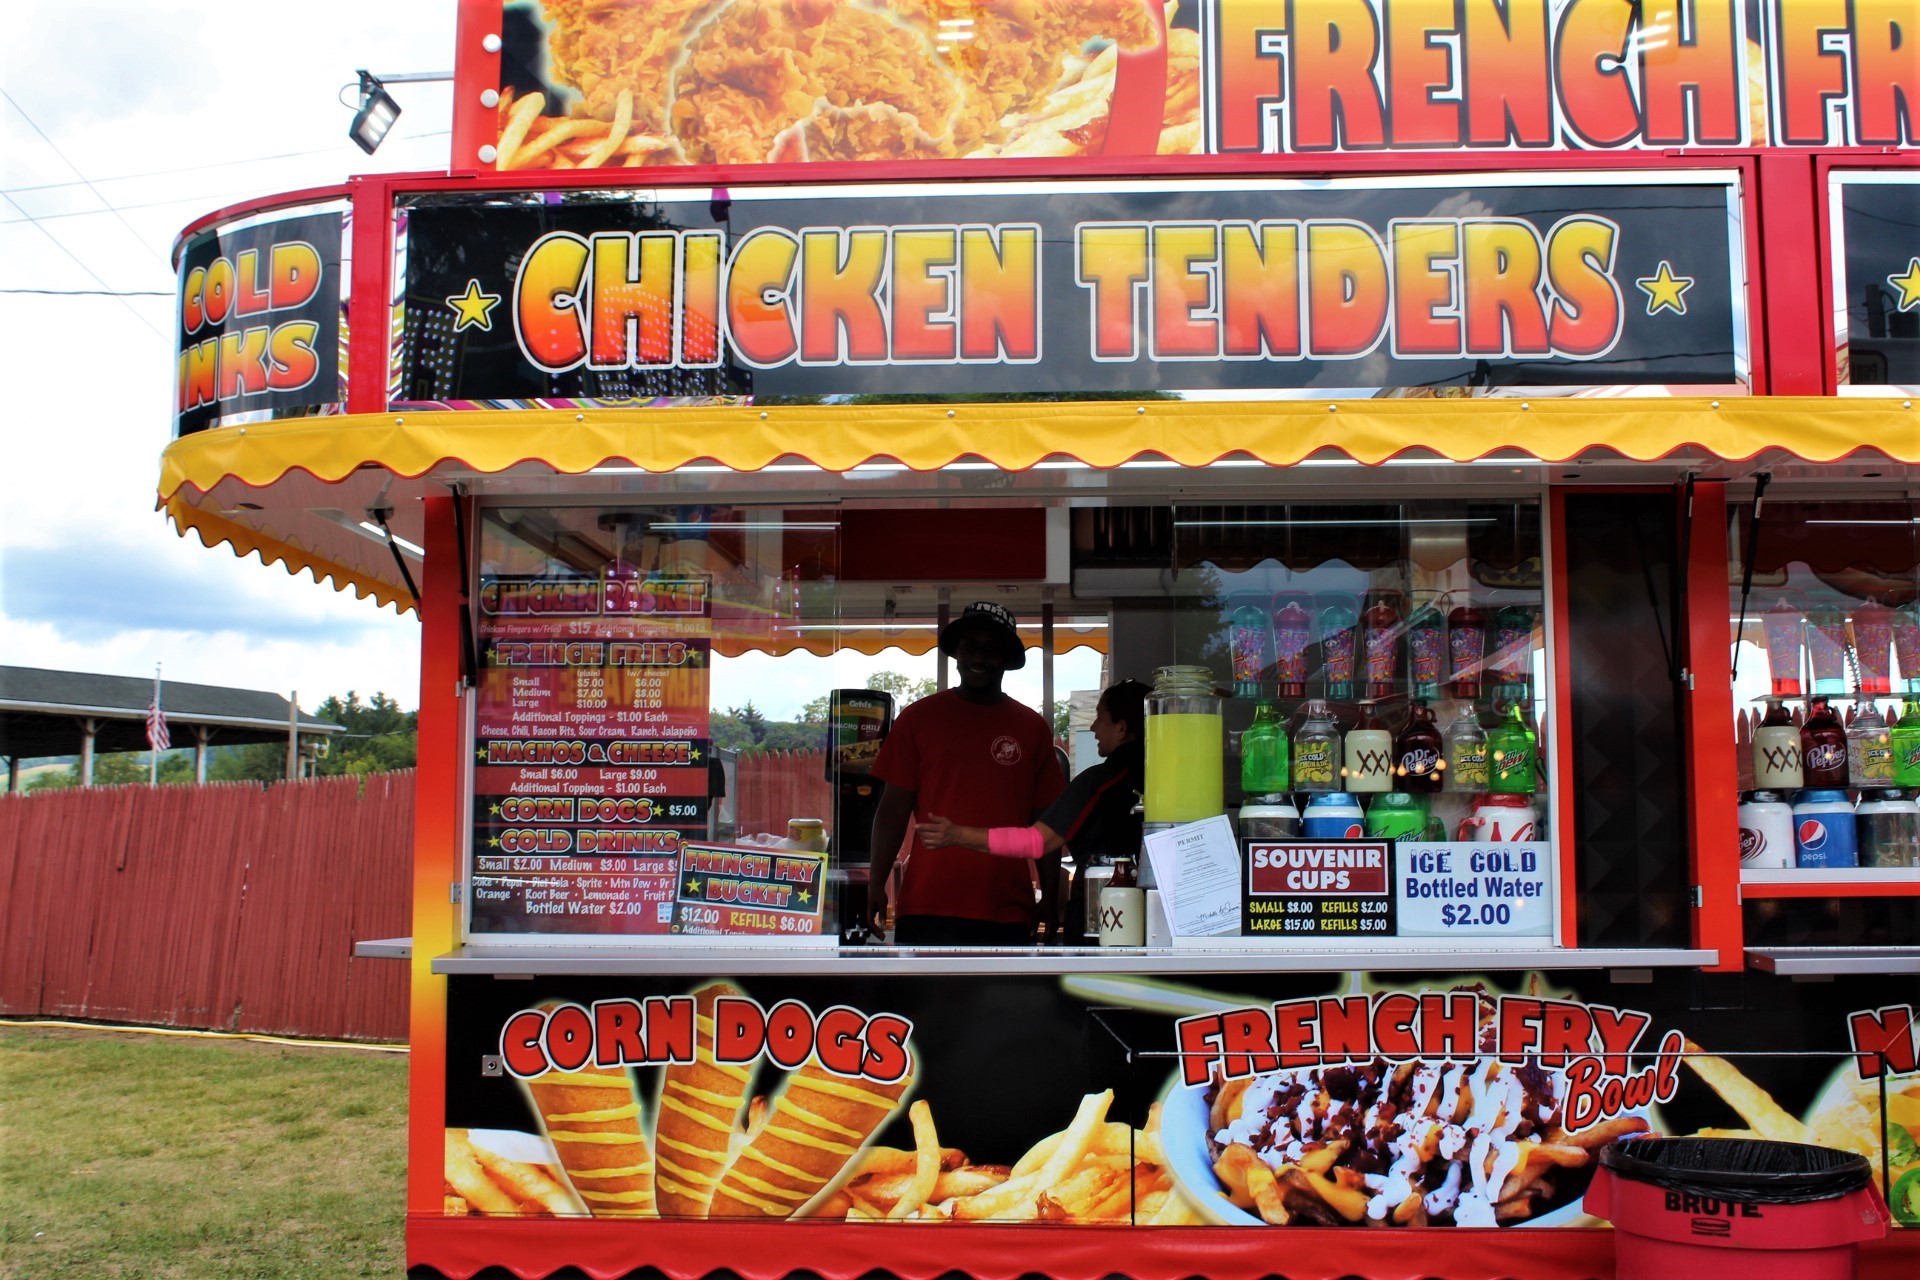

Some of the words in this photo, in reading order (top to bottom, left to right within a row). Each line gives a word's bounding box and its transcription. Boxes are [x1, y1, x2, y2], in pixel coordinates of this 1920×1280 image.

[1211, 0, 1745, 151] FRENCH
[184, 241, 322, 335] COLD
[513, 222, 1042, 372] CHICKEN
[1075, 213, 1625, 362] TENDERS
[180, 320, 319, 415] INKS
[481, 580, 599, 615] CHICKEN
[603, 580, 708, 614] BASKET
[507, 625, 531, 634] Fingers
[569, 621, 591, 634] $15
[596, 623, 634, 633] Additional
[637, 623, 668, 634] Toppings
[675, 623, 694, 633] $1.00
[496, 643, 603, 665] FRENCH
[610, 642, 687, 665] FRIES
[577, 669, 601, 677] (plain)
[513, 677, 539, 686] Small
[577, 678, 604, 687] $5.00
[635, 678, 661, 687] $6.00
[513, 688, 551, 697] Medium
[577, 689, 603, 698] $7.00
[635, 689, 660, 698] $8.00
[512, 698, 539, 708] Large
[576, 699, 607, 708] $10.00
[633, 699, 662, 708] $11.00
[512, 711, 562, 722] Additional
[564, 712, 606, 723] Toppings
[617, 711, 641, 722] $1.00
[644, 711, 668, 721] Each
[481, 725, 510, 736] Cheese,
[511, 725, 530, 736] Chili,
[532, 725, 557, 736] Bacon
[559, 725, 576, 736] Bits,
[578, 725, 596, 736] Sour
[598, 725, 627, 736] Cream,
[631, 725, 659, 736] Ranch,
[661, 725, 698, 738] Jalapeño
[488, 740, 585, 765] NACHOS
[588, 744, 606, 763] &
[606, 740, 691, 765] CHEESE
[1414, 749, 1430, 761] Dr
[1820, 744, 1836, 754] Dr
[1308, 753, 1324, 761] COLD
[520, 769, 547, 780] Small
[550, 769, 578, 780] $6.00
[599, 769, 627, 781] Large
[629, 769, 657, 780] $9.00
[510, 782, 560, 793] Additional
[563, 783, 605, 795] Toppings
[615, 782, 641, 794] $1.00
[643, 782, 667, 794] Each
[500, 797, 575, 822] CORN
[578, 797, 654, 823] DOGS
[669, 804, 697, 816] $5.00
[499, 828, 573, 854] COLD
[576, 829, 681, 854] DRINKS
[1177, 834, 1204, 847] PERMIT
[1254, 848, 1382, 869] SOUVENIR
[1411, 849, 1451, 873] ICE
[1470, 848, 1536, 873] COLD
[1802, 852, 1826, 862] pepsi
[478, 859, 510, 871] Small
[513, 859, 542, 871] $2.00
[550, 859, 593, 871] Medium
[600, 859, 627, 871] $3.00
[633, 860, 664, 873] Large
[684, 850, 771, 878] FRENCH
[775, 857, 818, 883] FRY
[501, 877, 523, 889] Pepsi
[532, 877, 548, 888] Diet
[550, 878, 569, 888] Cola
[576, 877, 602, 889] Sprite
[610, 878, 631, 889] Mtn
[633, 878, 651, 889] Dew
[659, 878, 670, 888] Dr
[1286, 870, 1351, 891] CUPS
[706, 878, 792, 907] BUCKET
[1406, 877, 1478, 899] Bottled
[1485, 877, 1544, 899] Water
[476, 890, 511, 901] Orange
[525, 890, 546, 900] Root
[550, 889, 570, 900] Beer
[583, 890, 630, 901] Lemonade
[643, 890, 666, 901] Fruit
[526, 901, 564, 914] Bottled
[568, 902, 606, 914] Water
[609, 902, 641, 915] $2.00
[1249, 901, 1285, 914] SMALL
[1287, 901, 1313, 914] $8.00
[1321, 901, 1358, 914] REFILLS
[1361, 901, 1388, 914] $2.00
[680, 906, 719, 924] $12.00
[730, 911, 776, 930] REFILLS
[780, 916, 813, 933] $6.00
[1441, 902, 1511, 927] $2.00
[1251, 919, 1282, 931] LARGE
[1284, 919, 1315, 931] $15.00
[1320, 919, 1357, 931] REFILLS
[1360, 919, 1387, 931] $5.00
[501, 996, 697, 1078] CORN
[714, 996, 914, 1084] DOGS
[1175, 990, 1494, 1089] FRENCH
[1497, 991, 1652, 1079] FRY
[1561, 1030, 1685, 1135] Bowl
